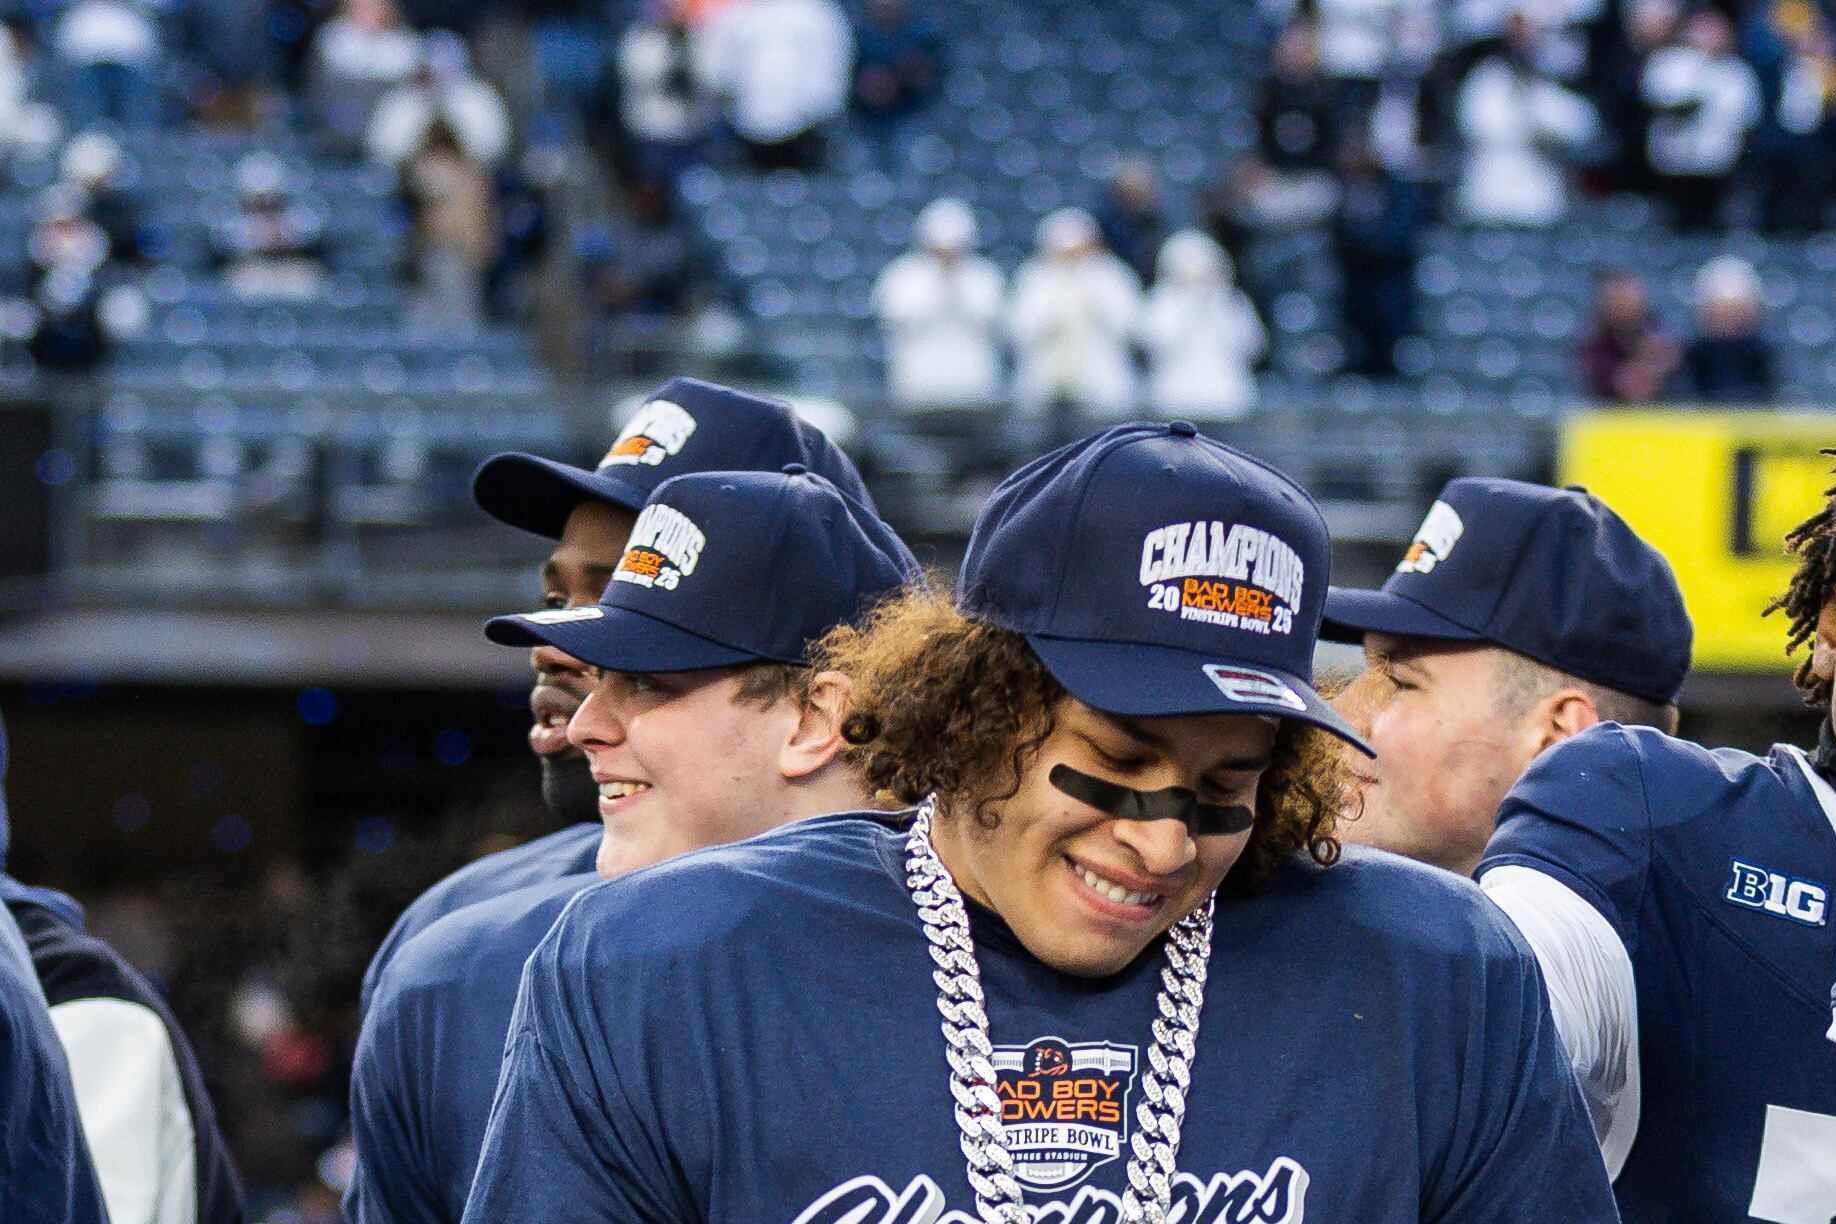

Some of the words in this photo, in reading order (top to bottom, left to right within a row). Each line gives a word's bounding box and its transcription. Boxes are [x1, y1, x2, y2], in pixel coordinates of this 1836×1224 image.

[1139, 521, 1304, 616] CHAMPIONS
[1148, 583, 1181, 612] 20
[1184, 578, 1229, 600] BAD
[1234, 585, 1273, 604] BOY
[1183, 593, 1272, 623] MOWERS
[1272, 606, 1293, 635] 25
[996, 1079, 1042, 1100] AD
[1053, 1078, 1121, 1100] BOY
[1000, 1099, 1121, 1123] OWERS
[1005, 1127, 1060, 1147] STRIPE
[1067, 1127, 1114, 1151] BOWL
